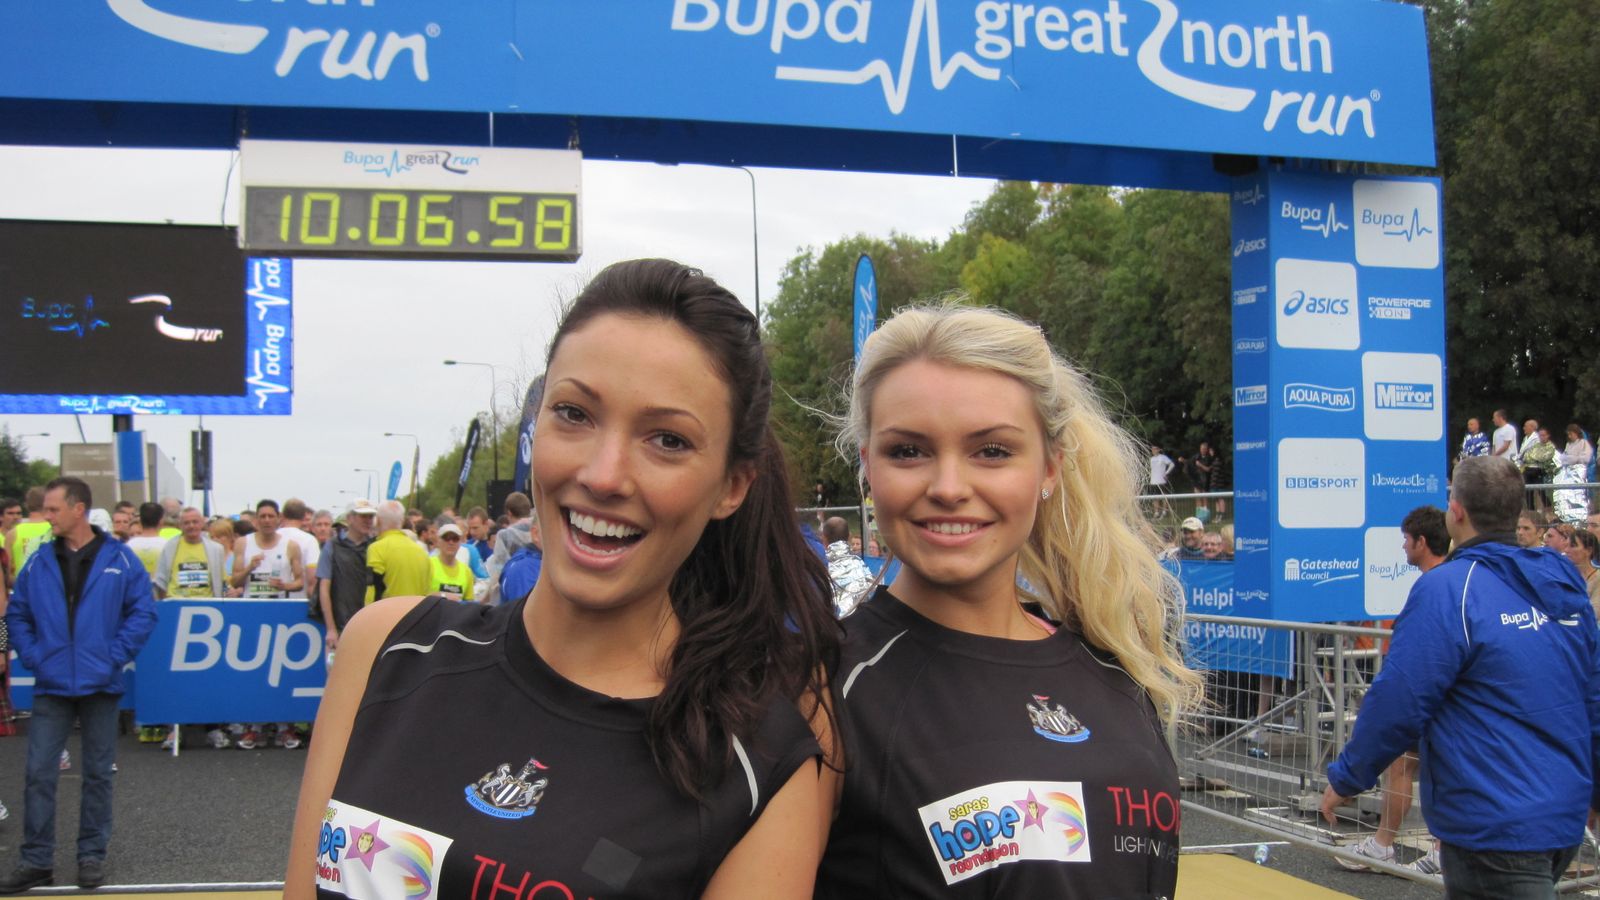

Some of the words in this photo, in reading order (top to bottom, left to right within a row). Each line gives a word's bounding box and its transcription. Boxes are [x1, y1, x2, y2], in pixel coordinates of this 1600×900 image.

[975, 0, 1128, 60] great
[1182, 15, 1333, 74] north
[343, 150, 384, 167] Bupa
[406, 153, 440, 167] great
[452, 155, 480, 166] run
[1281, 201, 1321, 223] Bupa
[1361, 208, 1404, 228] Bupa
[1368, 296, 1432, 308] POWERADE
[262, 323, 285, 376] Bupa
[1289, 388, 1320, 403] AQUA
[1321, 390, 1351, 406] PURA
[1376, 384, 1432, 407] Mirror
[1320, 478, 1359, 489] SPORT
[1372, 472, 1425, 486] Newcastle
[1301, 558, 1359, 570] Gateshead
[1369, 564, 1391, 574] Bupa
[1301, 571, 1329, 580] Council
[1500, 612, 1530, 625] Bupa
[170, 605, 322, 688] Bup
[948, 796, 989, 821] saras
[1107, 786, 1181, 834] THO
[929, 806, 1020, 862] hope
